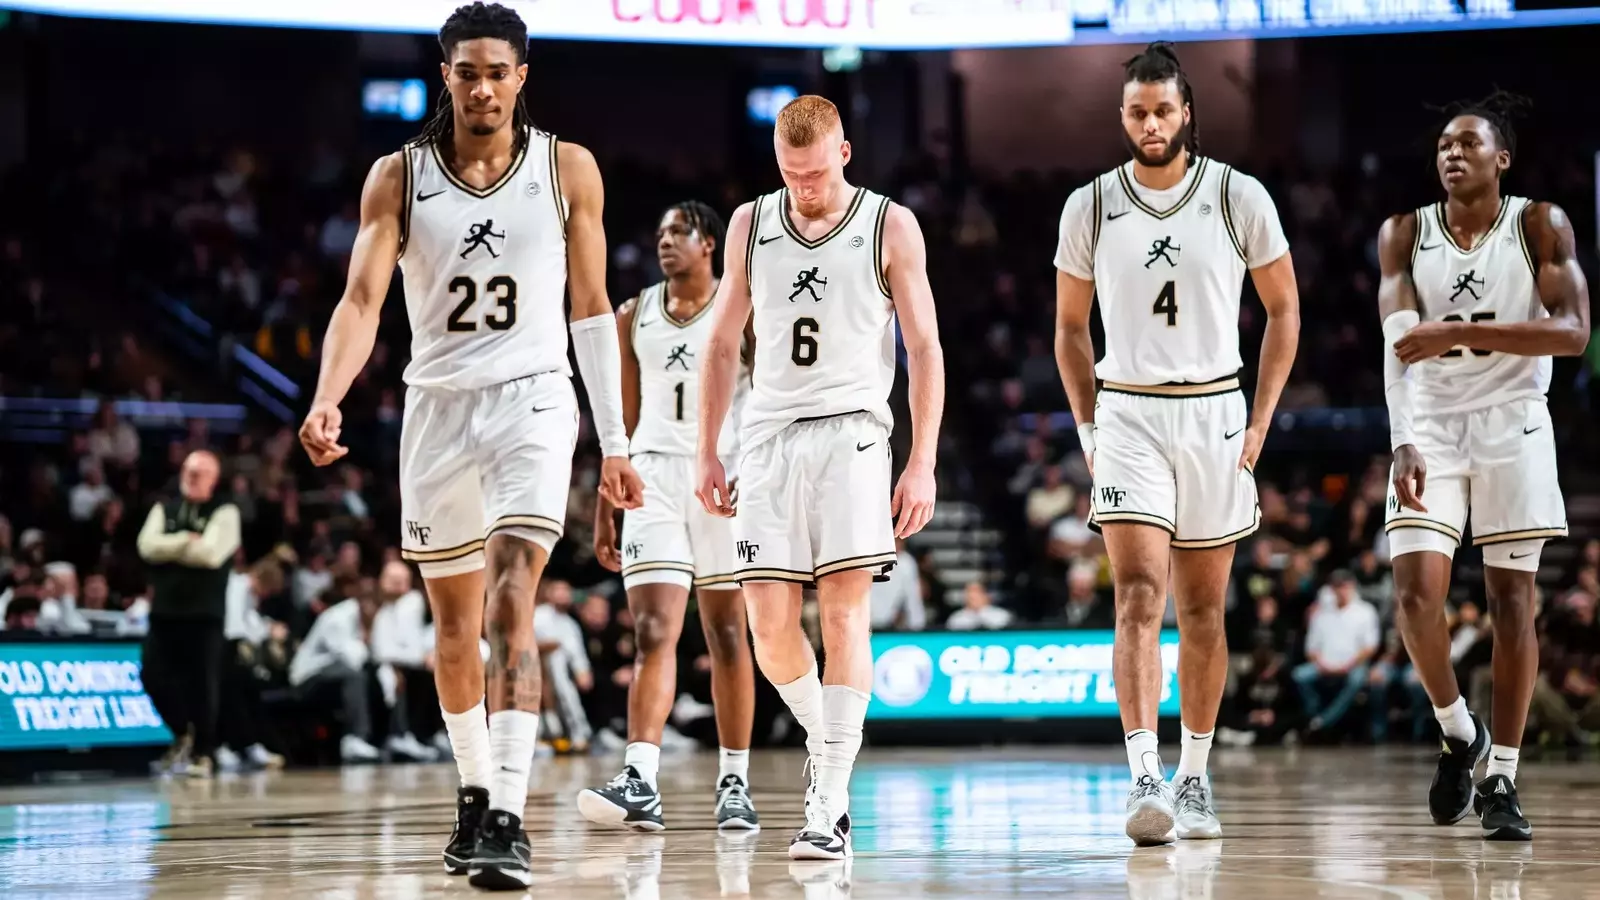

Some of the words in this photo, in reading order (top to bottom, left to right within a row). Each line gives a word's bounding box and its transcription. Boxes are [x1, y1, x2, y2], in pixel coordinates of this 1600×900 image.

[446, 275, 518, 332] 23
[1152, 279, 1179, 328] 4
[790, 316, 820, 367] 6
[673, 381, 685, 421] 1
[1101, 486, 1127, 508] WF
[405, 519, 432, 546] WF
[736, 540, 760, 563] WF
[0, 660, 44, 695] OLD
